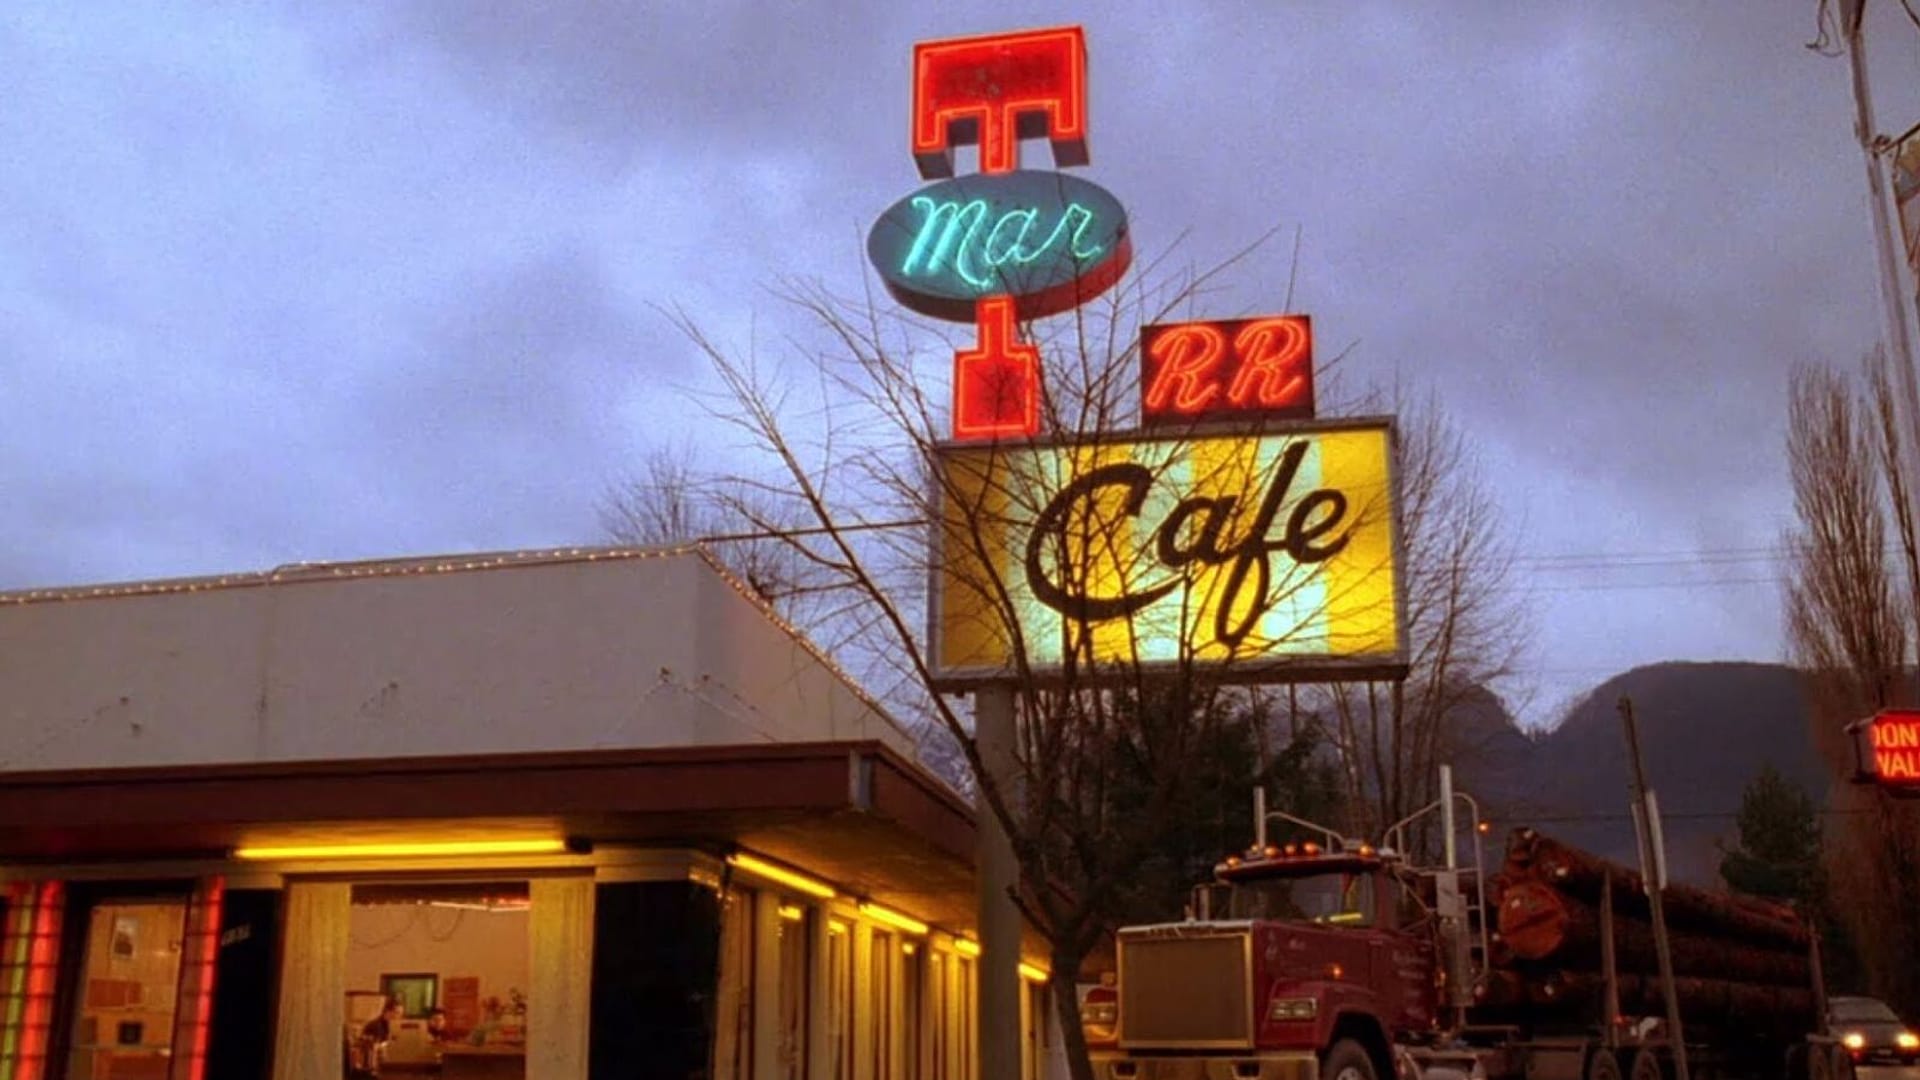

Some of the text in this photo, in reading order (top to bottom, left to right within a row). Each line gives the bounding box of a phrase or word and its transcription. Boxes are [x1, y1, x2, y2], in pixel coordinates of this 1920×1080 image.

[903, 196, 1102, 291] Mar
[1026, 440, 1349, 649] Cafe
[1876, 751, 1920, 777] WAL
